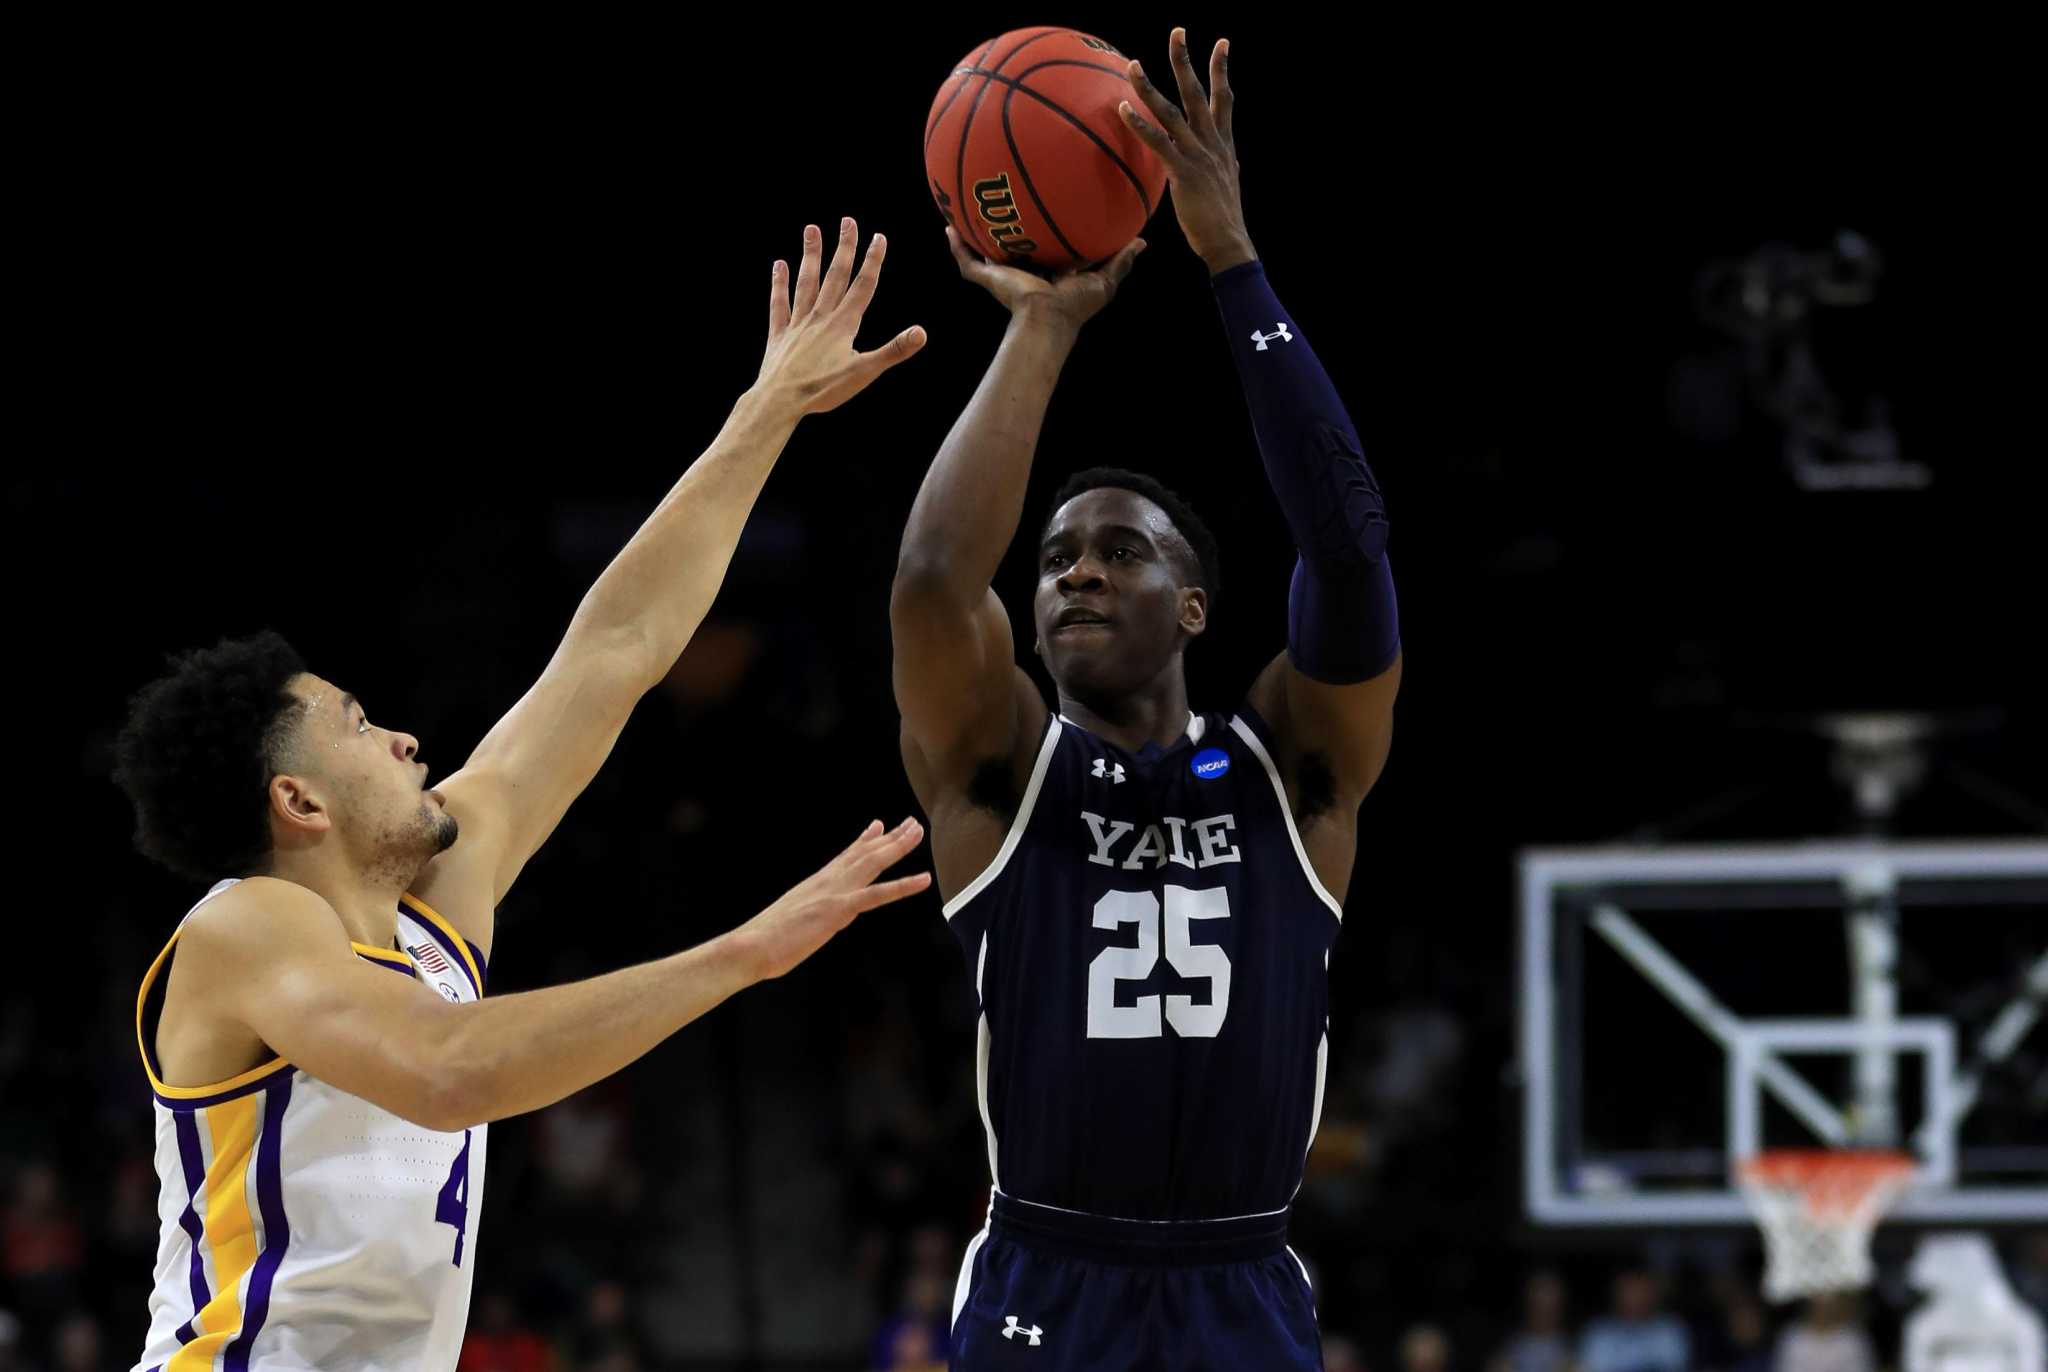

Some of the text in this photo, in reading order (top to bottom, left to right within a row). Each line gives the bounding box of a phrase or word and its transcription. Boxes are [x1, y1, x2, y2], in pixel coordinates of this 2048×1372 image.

[1197, 759, 1229, 774] NCAA
[1080, 811, 1241, 870] YALE
[1087, 884, 1232, 1039] 25
[434, 1129, 472, 1268] 4
